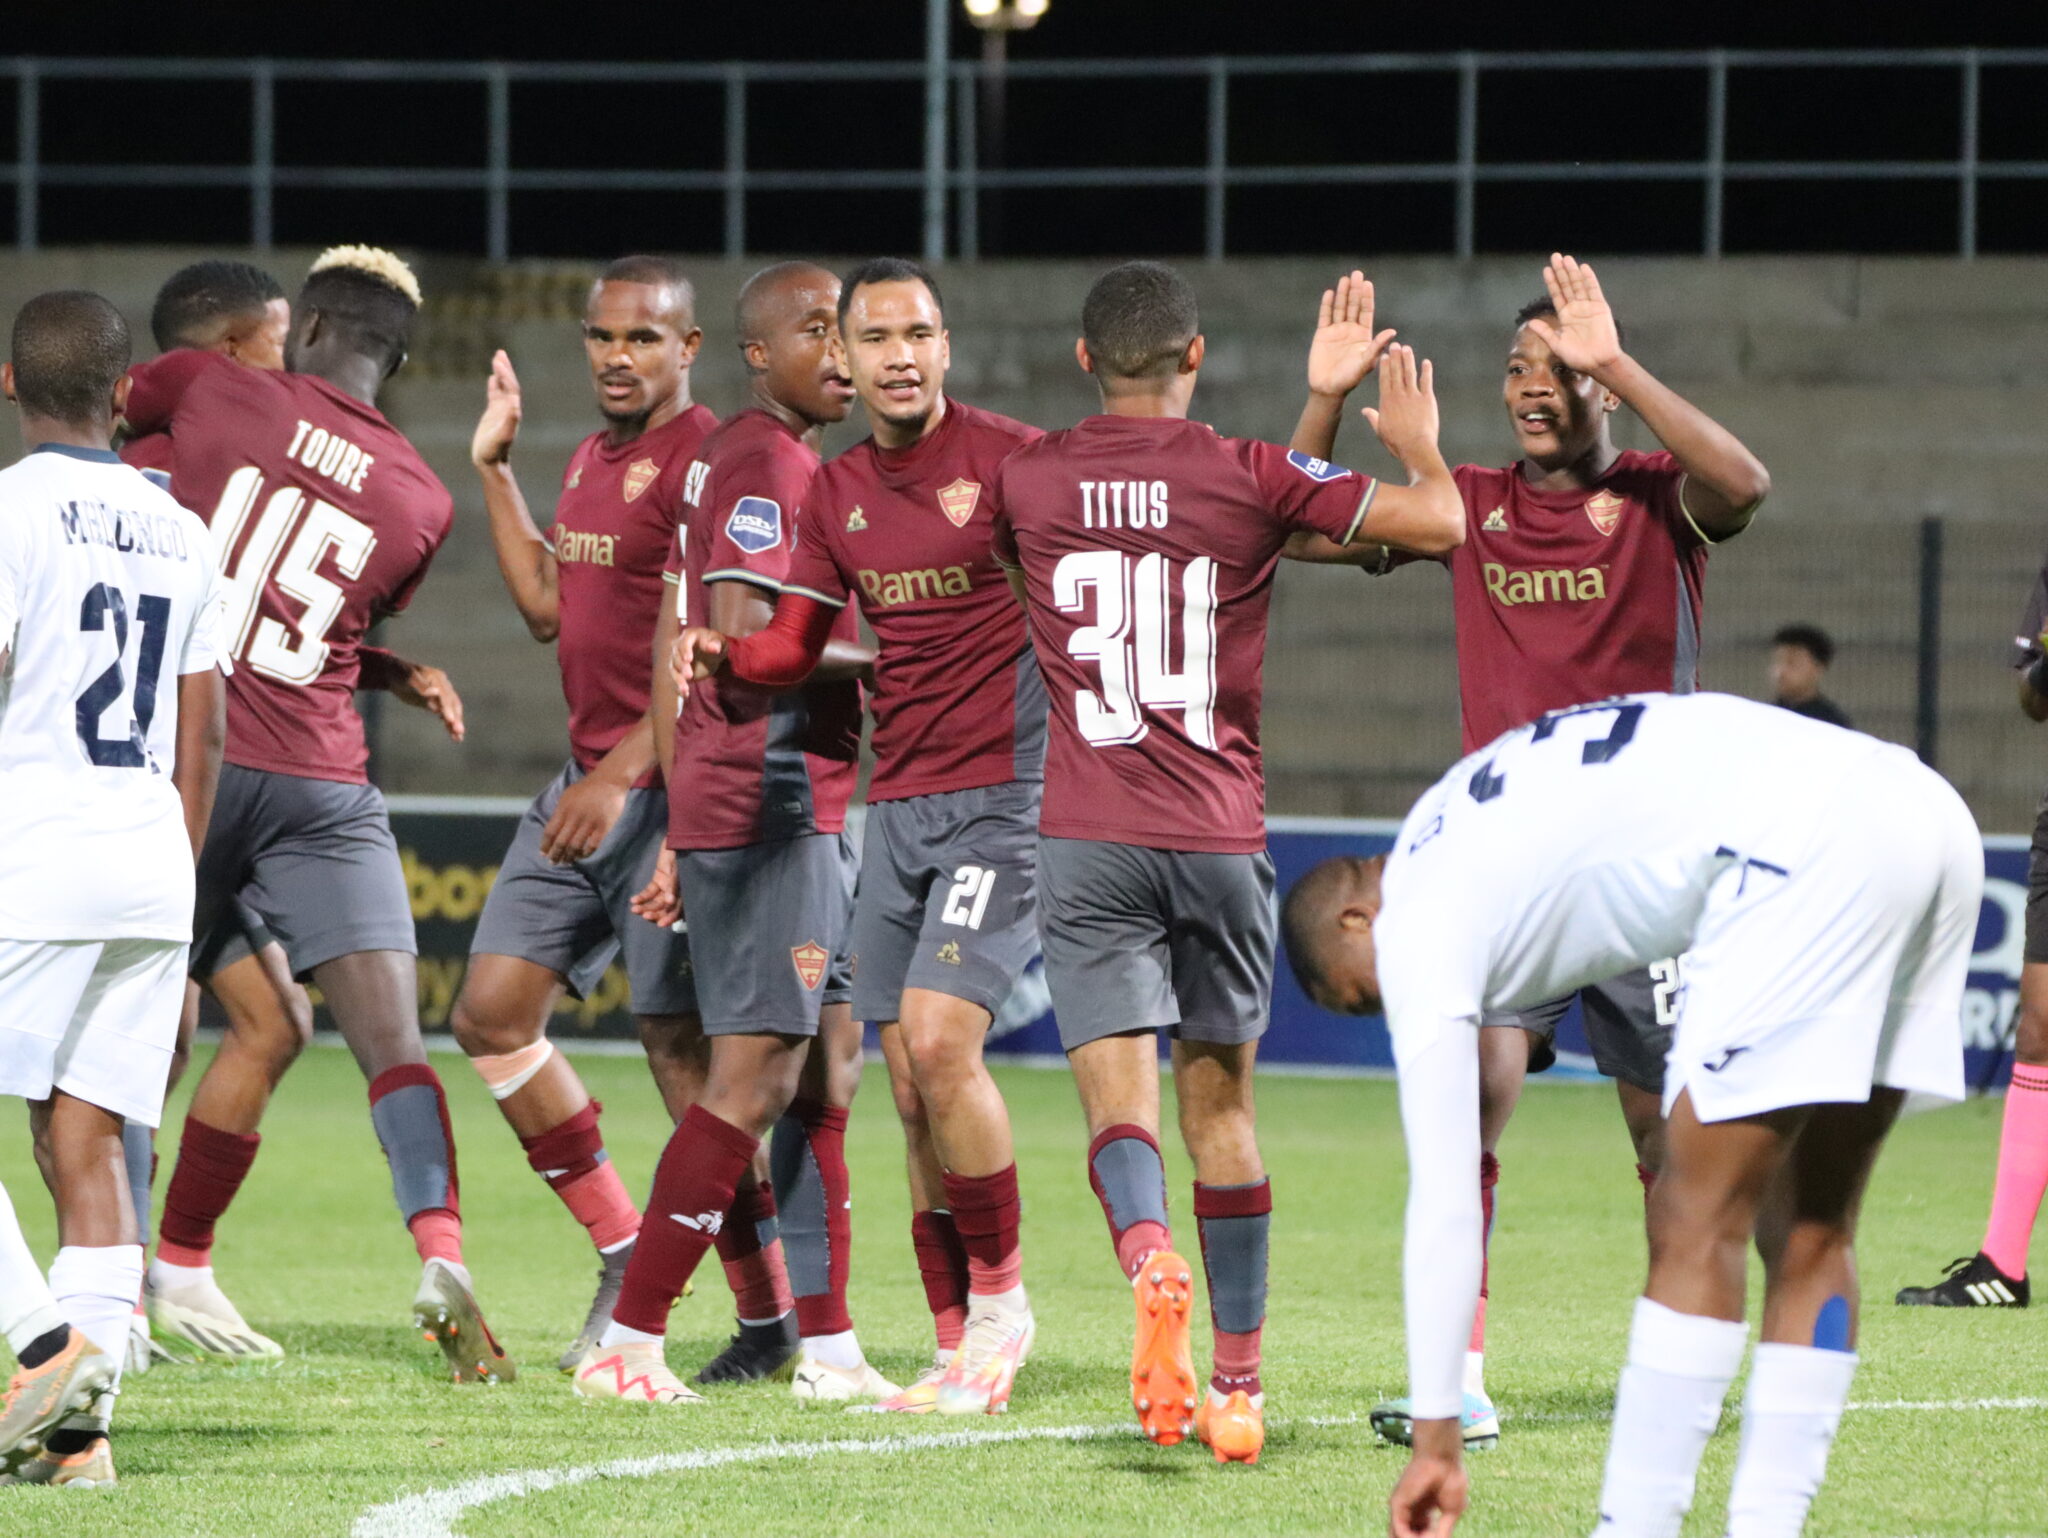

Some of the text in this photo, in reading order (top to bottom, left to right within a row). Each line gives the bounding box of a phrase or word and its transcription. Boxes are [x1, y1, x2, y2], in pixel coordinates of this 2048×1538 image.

[286, 419, 375, 493] TOURE
[1079, 480, 1169, 529] TITUS
[208, 466, 378, 686] 45
[554, 522, 616, 567] Rama
[857, 564, 973, 608] Rama
[1483, 562, 1606, 606] Rama
[75, 580, 172, 774] 21
[1052, 550, 1219, 751] 34
[941, 865, 997, 931] 21
